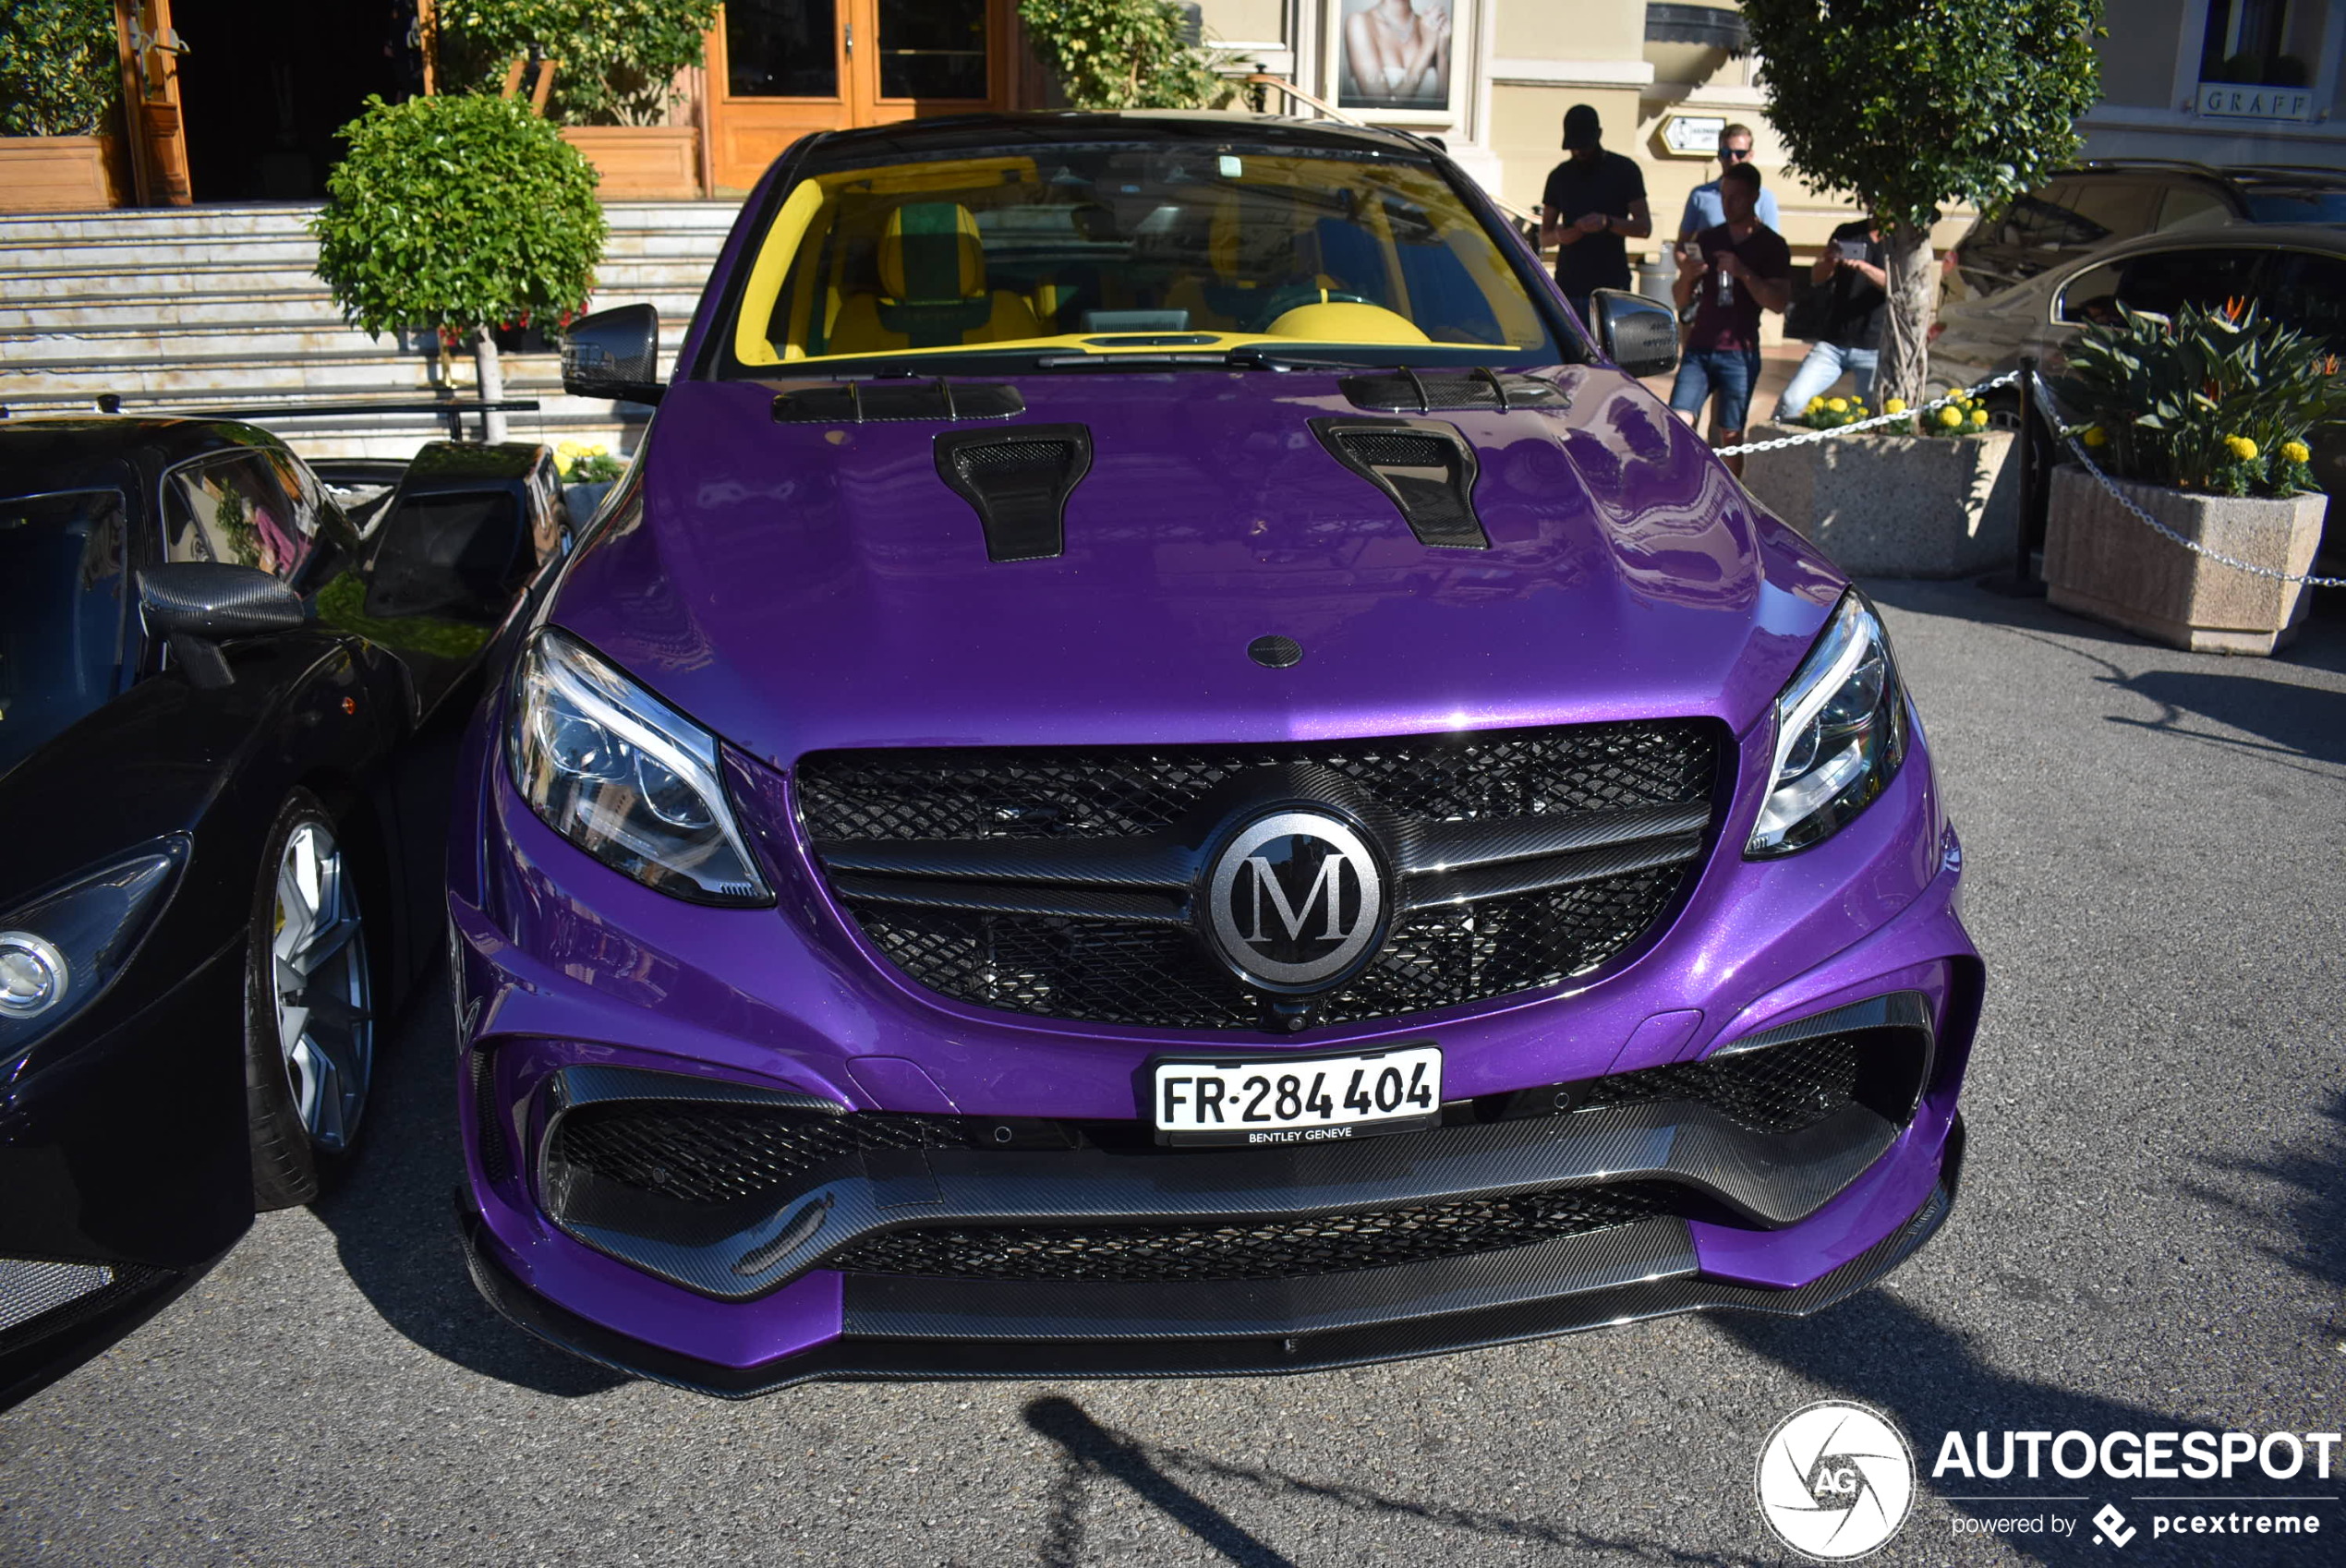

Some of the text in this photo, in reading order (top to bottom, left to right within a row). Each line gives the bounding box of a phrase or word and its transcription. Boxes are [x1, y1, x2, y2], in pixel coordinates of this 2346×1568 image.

[2207, 91, 2304, 115] GRAFF
[1243, 853, 1349, 942] M
[1343, 1062, 1433, 1115] 404
[1249, 1127, 1352, 1143] BENTLEY GENEVE
